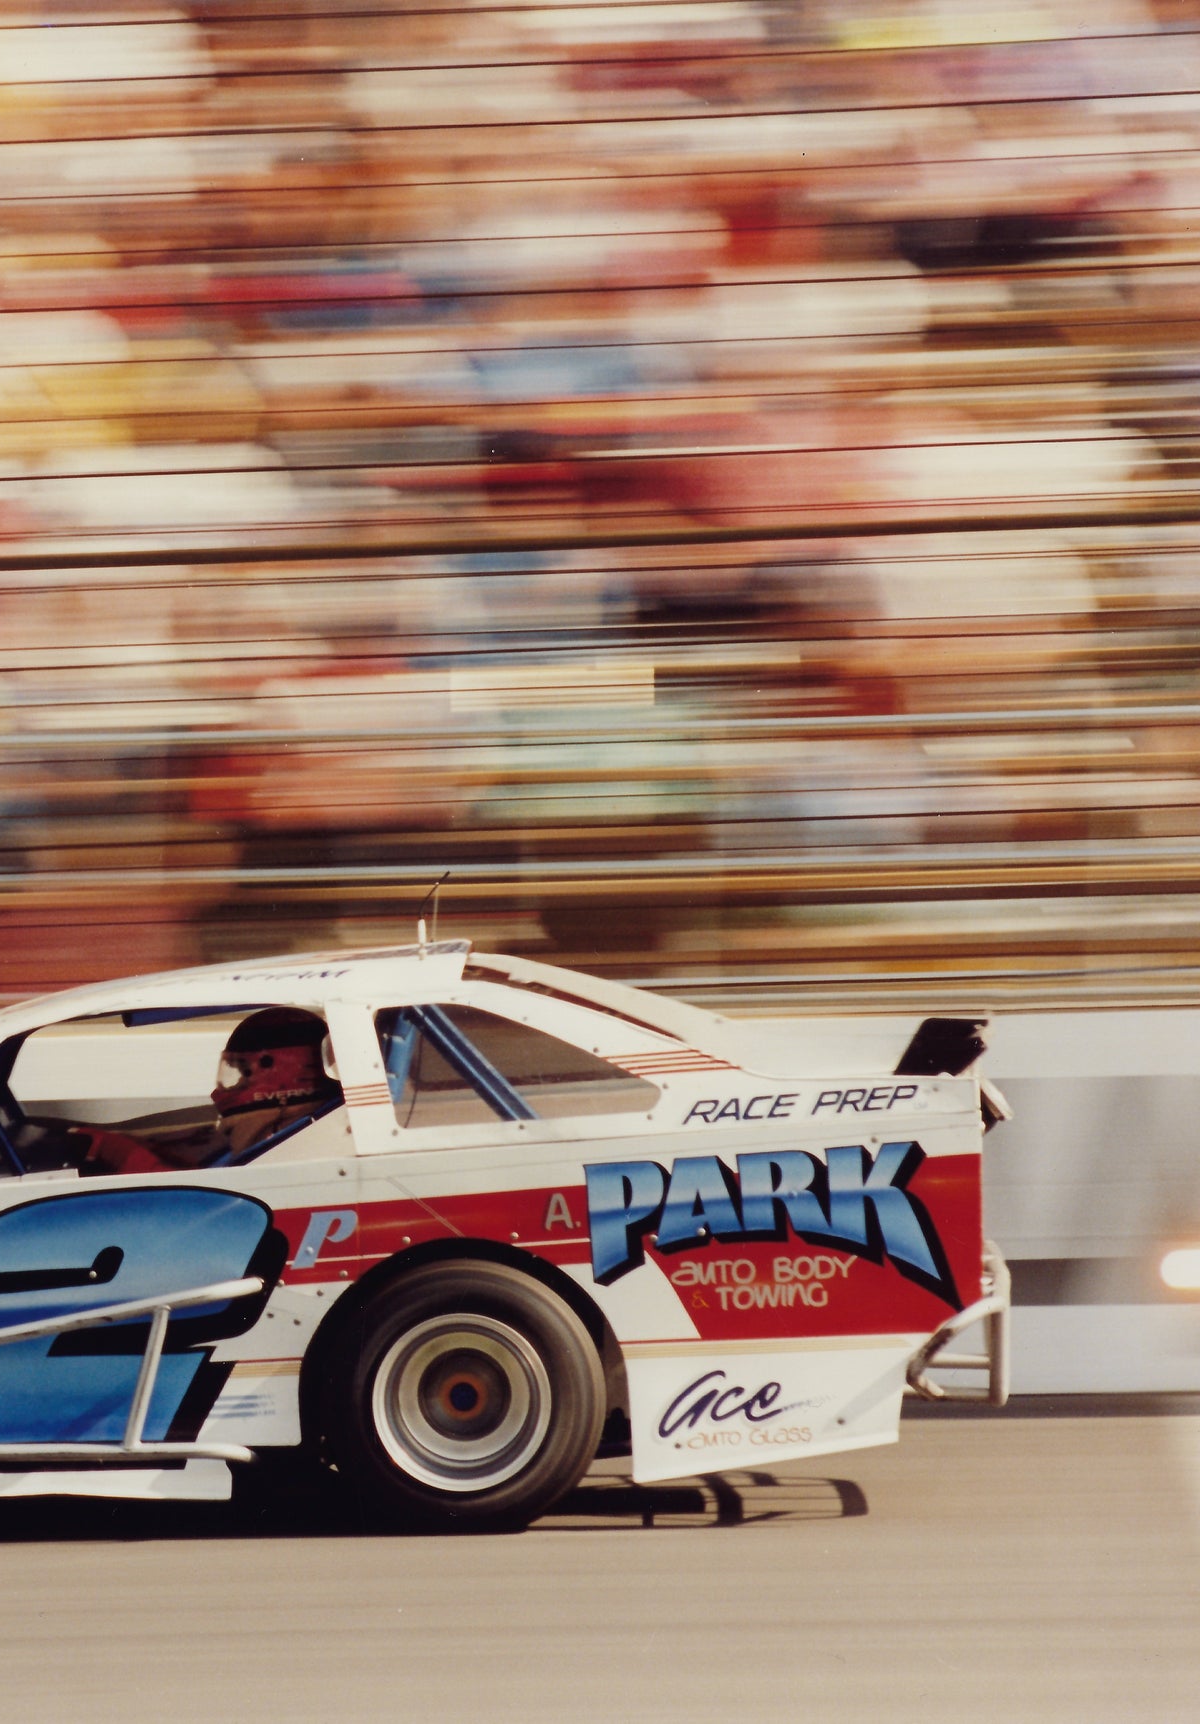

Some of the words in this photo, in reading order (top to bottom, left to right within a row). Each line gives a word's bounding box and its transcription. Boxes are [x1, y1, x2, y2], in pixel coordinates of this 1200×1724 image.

[682, 1093, 800, 1125] RACE
[811, 1084, 918, 1116] PREP
[292, 1209, 359, 1270] P
[583, 1141, 965, 1313] PARK
[773, 1255, 858, 1283] BODY
[691, 1291, 710, 1309] &
[715, 1282, 829, 1310] TOWING
